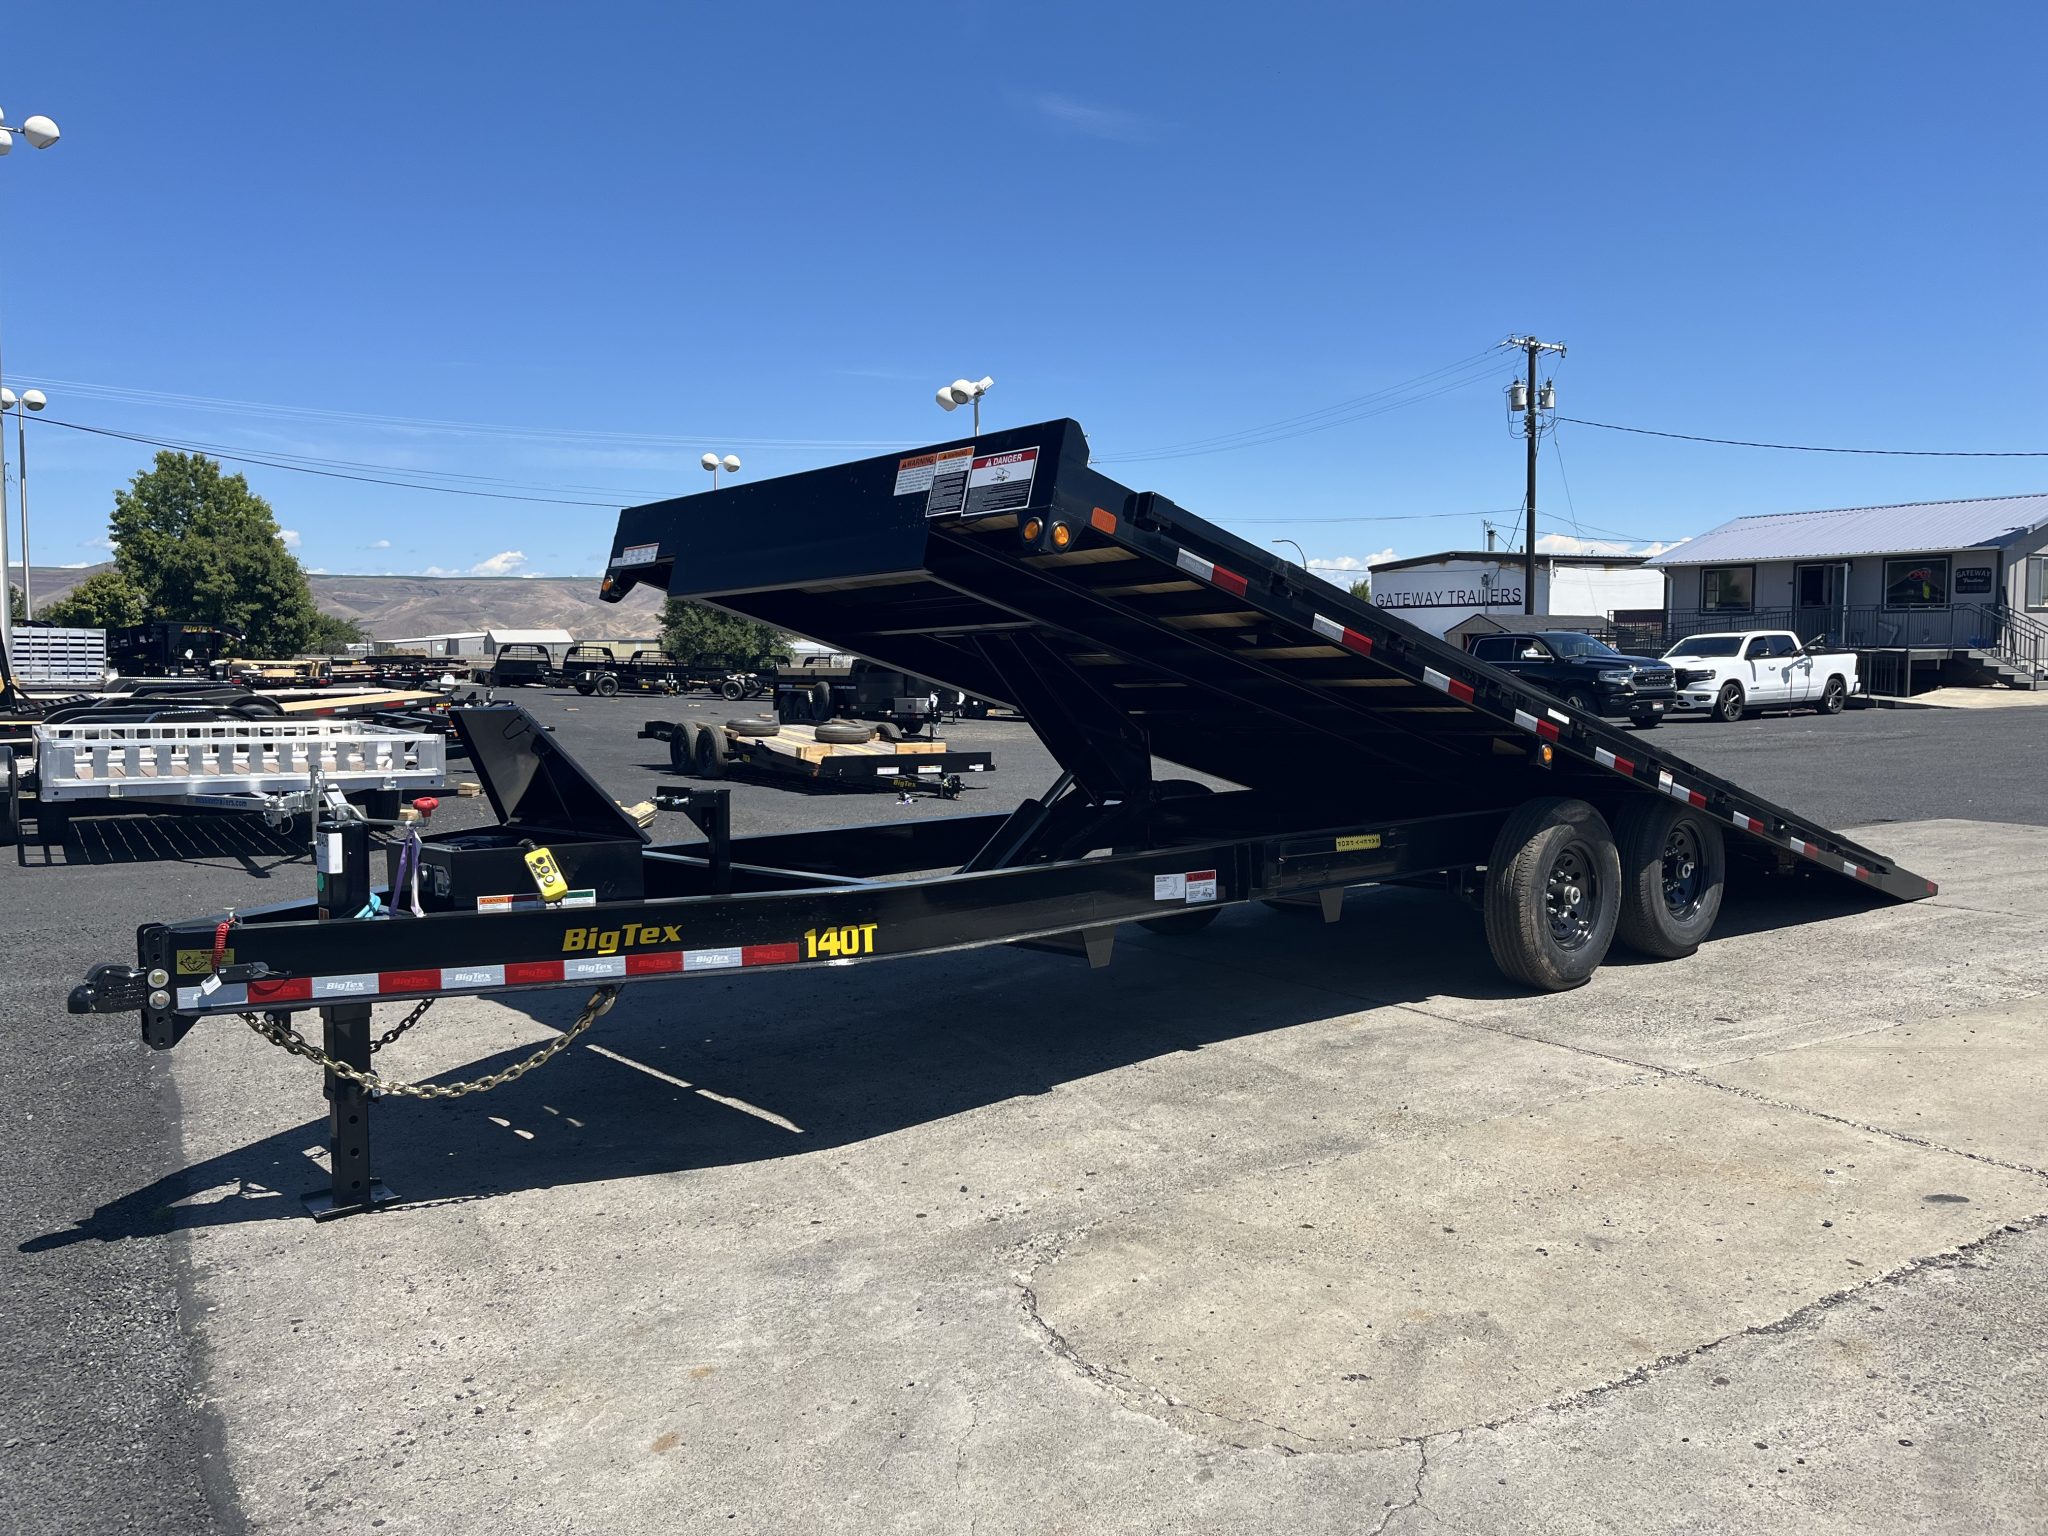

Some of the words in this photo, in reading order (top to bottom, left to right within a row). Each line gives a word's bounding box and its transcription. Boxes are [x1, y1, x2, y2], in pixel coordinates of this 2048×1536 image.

[906, 456, 934, 467] WARNING
[993, 454, 1023, 466] DANGER
[1956, 569, 1992, 578] GATEWAY
[1375, 591, 1443, 607] GATEWAY
[1448, 588, 1522, 604] TRAILERS
[562, 923, 683, 955] BigTex
[804, 923, 878, 958] 140T
[696, 954, 729, 964] BigTex
[577, 963, 613, 973] BigTex
[455, 972, 492, 981] BigTex
[326, 981, 365, 991] BigTex
